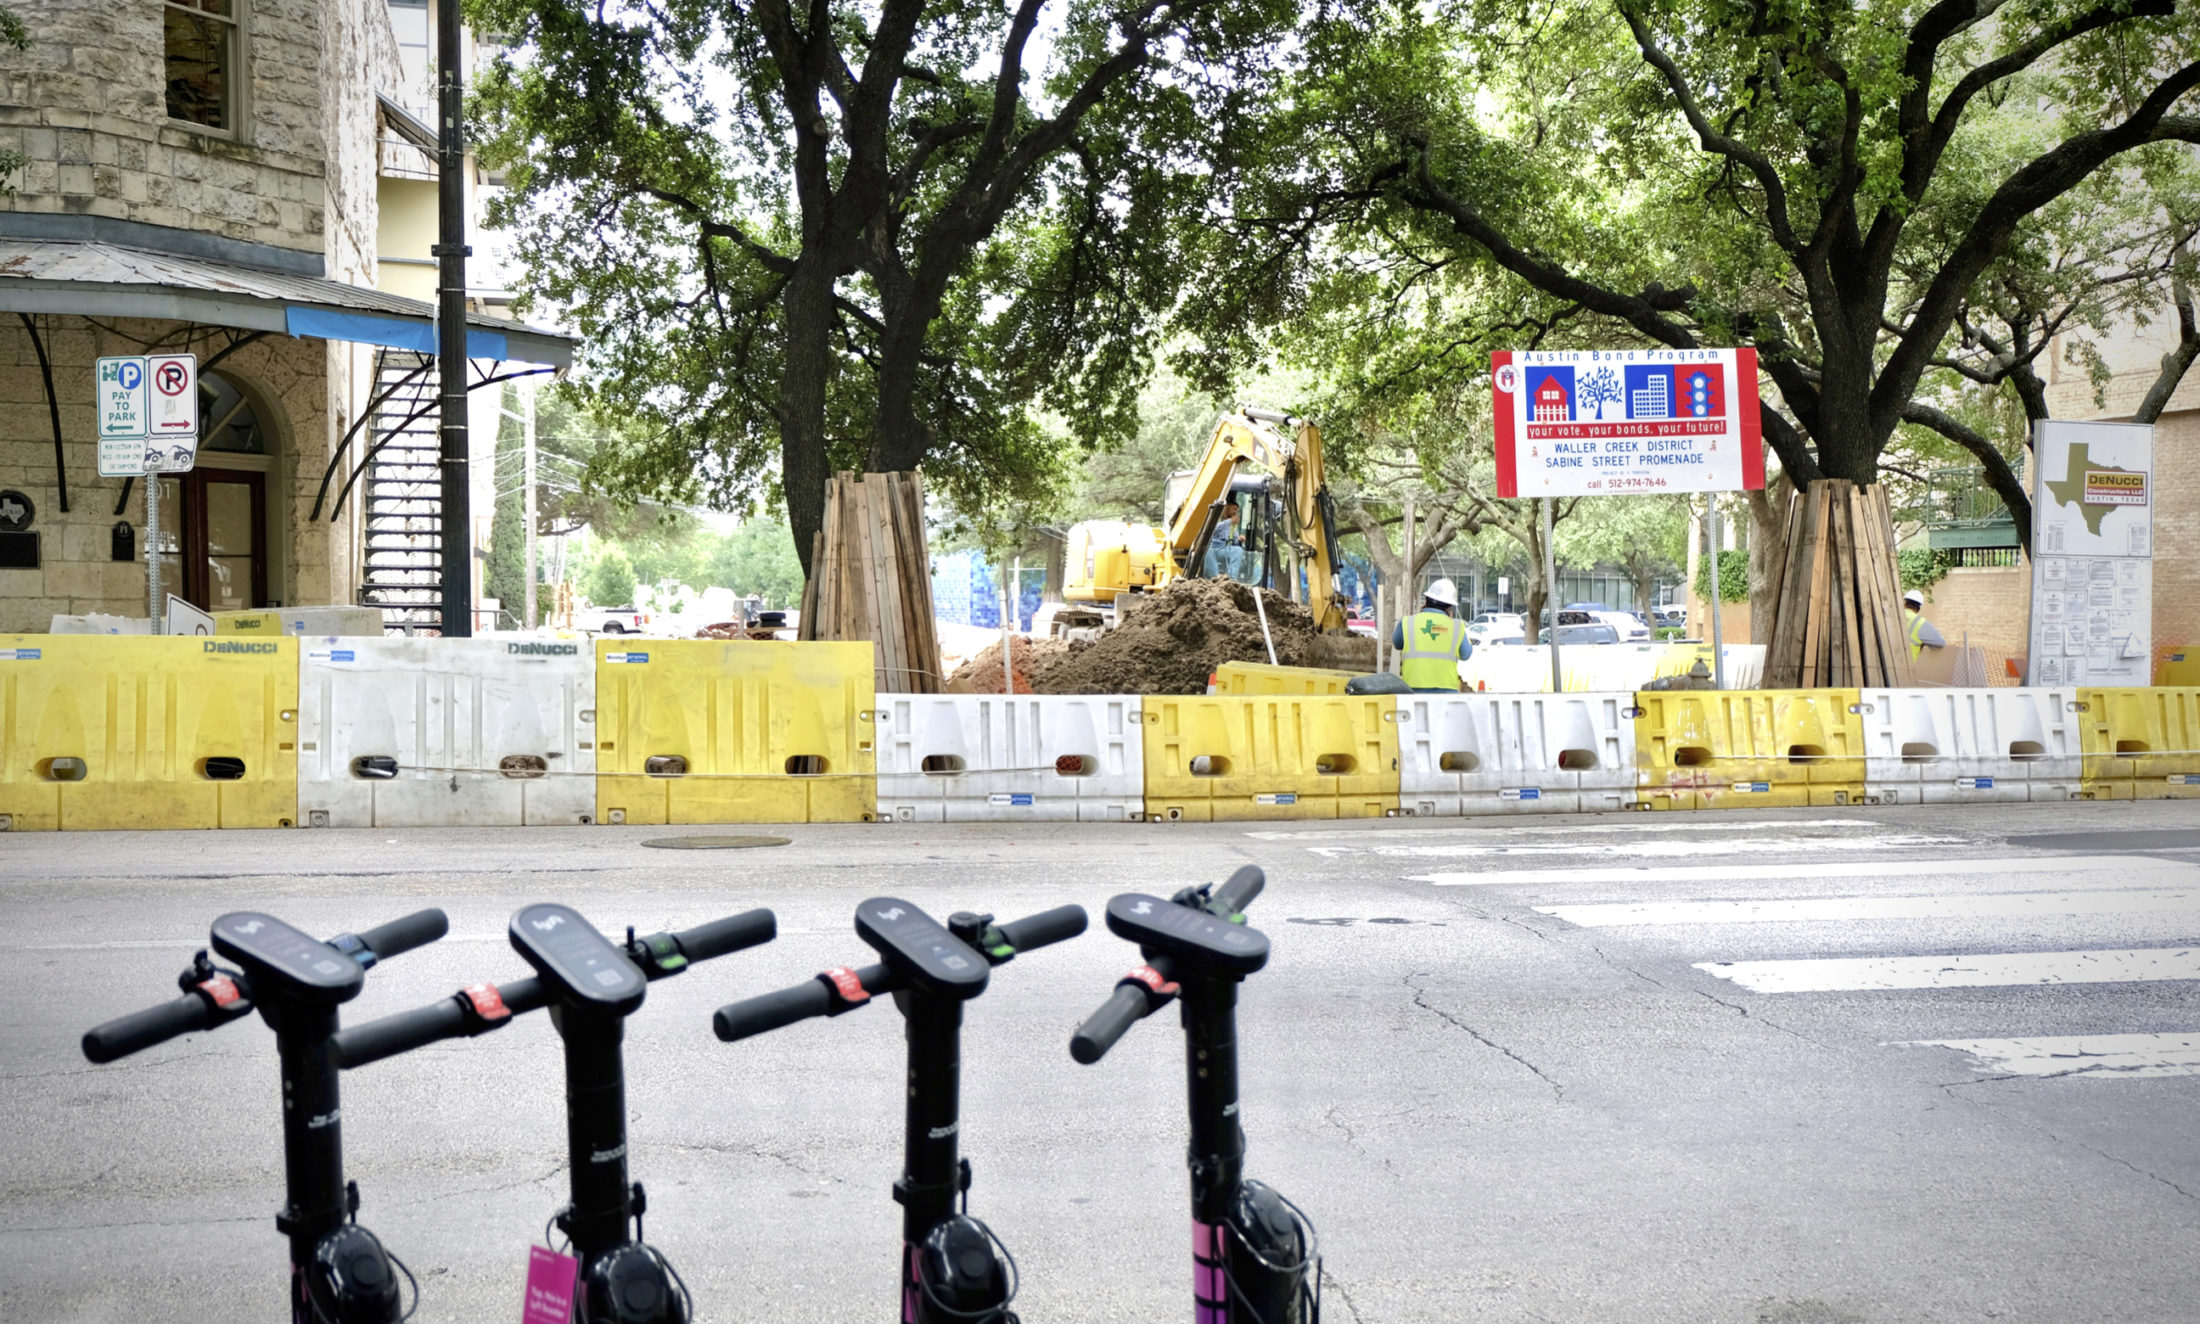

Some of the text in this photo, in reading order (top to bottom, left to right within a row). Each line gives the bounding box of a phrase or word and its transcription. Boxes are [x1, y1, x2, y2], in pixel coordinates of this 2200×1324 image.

[1524, 349, 1718, 362] Austin Bond Program
[112, 391, 131, 401] PAY
[115, 402, 130, 411] TO
[108, 412, 136, 422] PARK
[1529, 427, 1553, 439] your
[1588, 425, 1612, 437] your
[1658, 423, 1681, 436] your
[1686, 421, 1724, 433] future!
[1554, 440, 1693, 454] WALLER CREEK DISTRICT
[1545, 453, 1704, 468] SABINE STREET PROMENADE
[1587, 478, 1667, 489] call 512-974-7646
